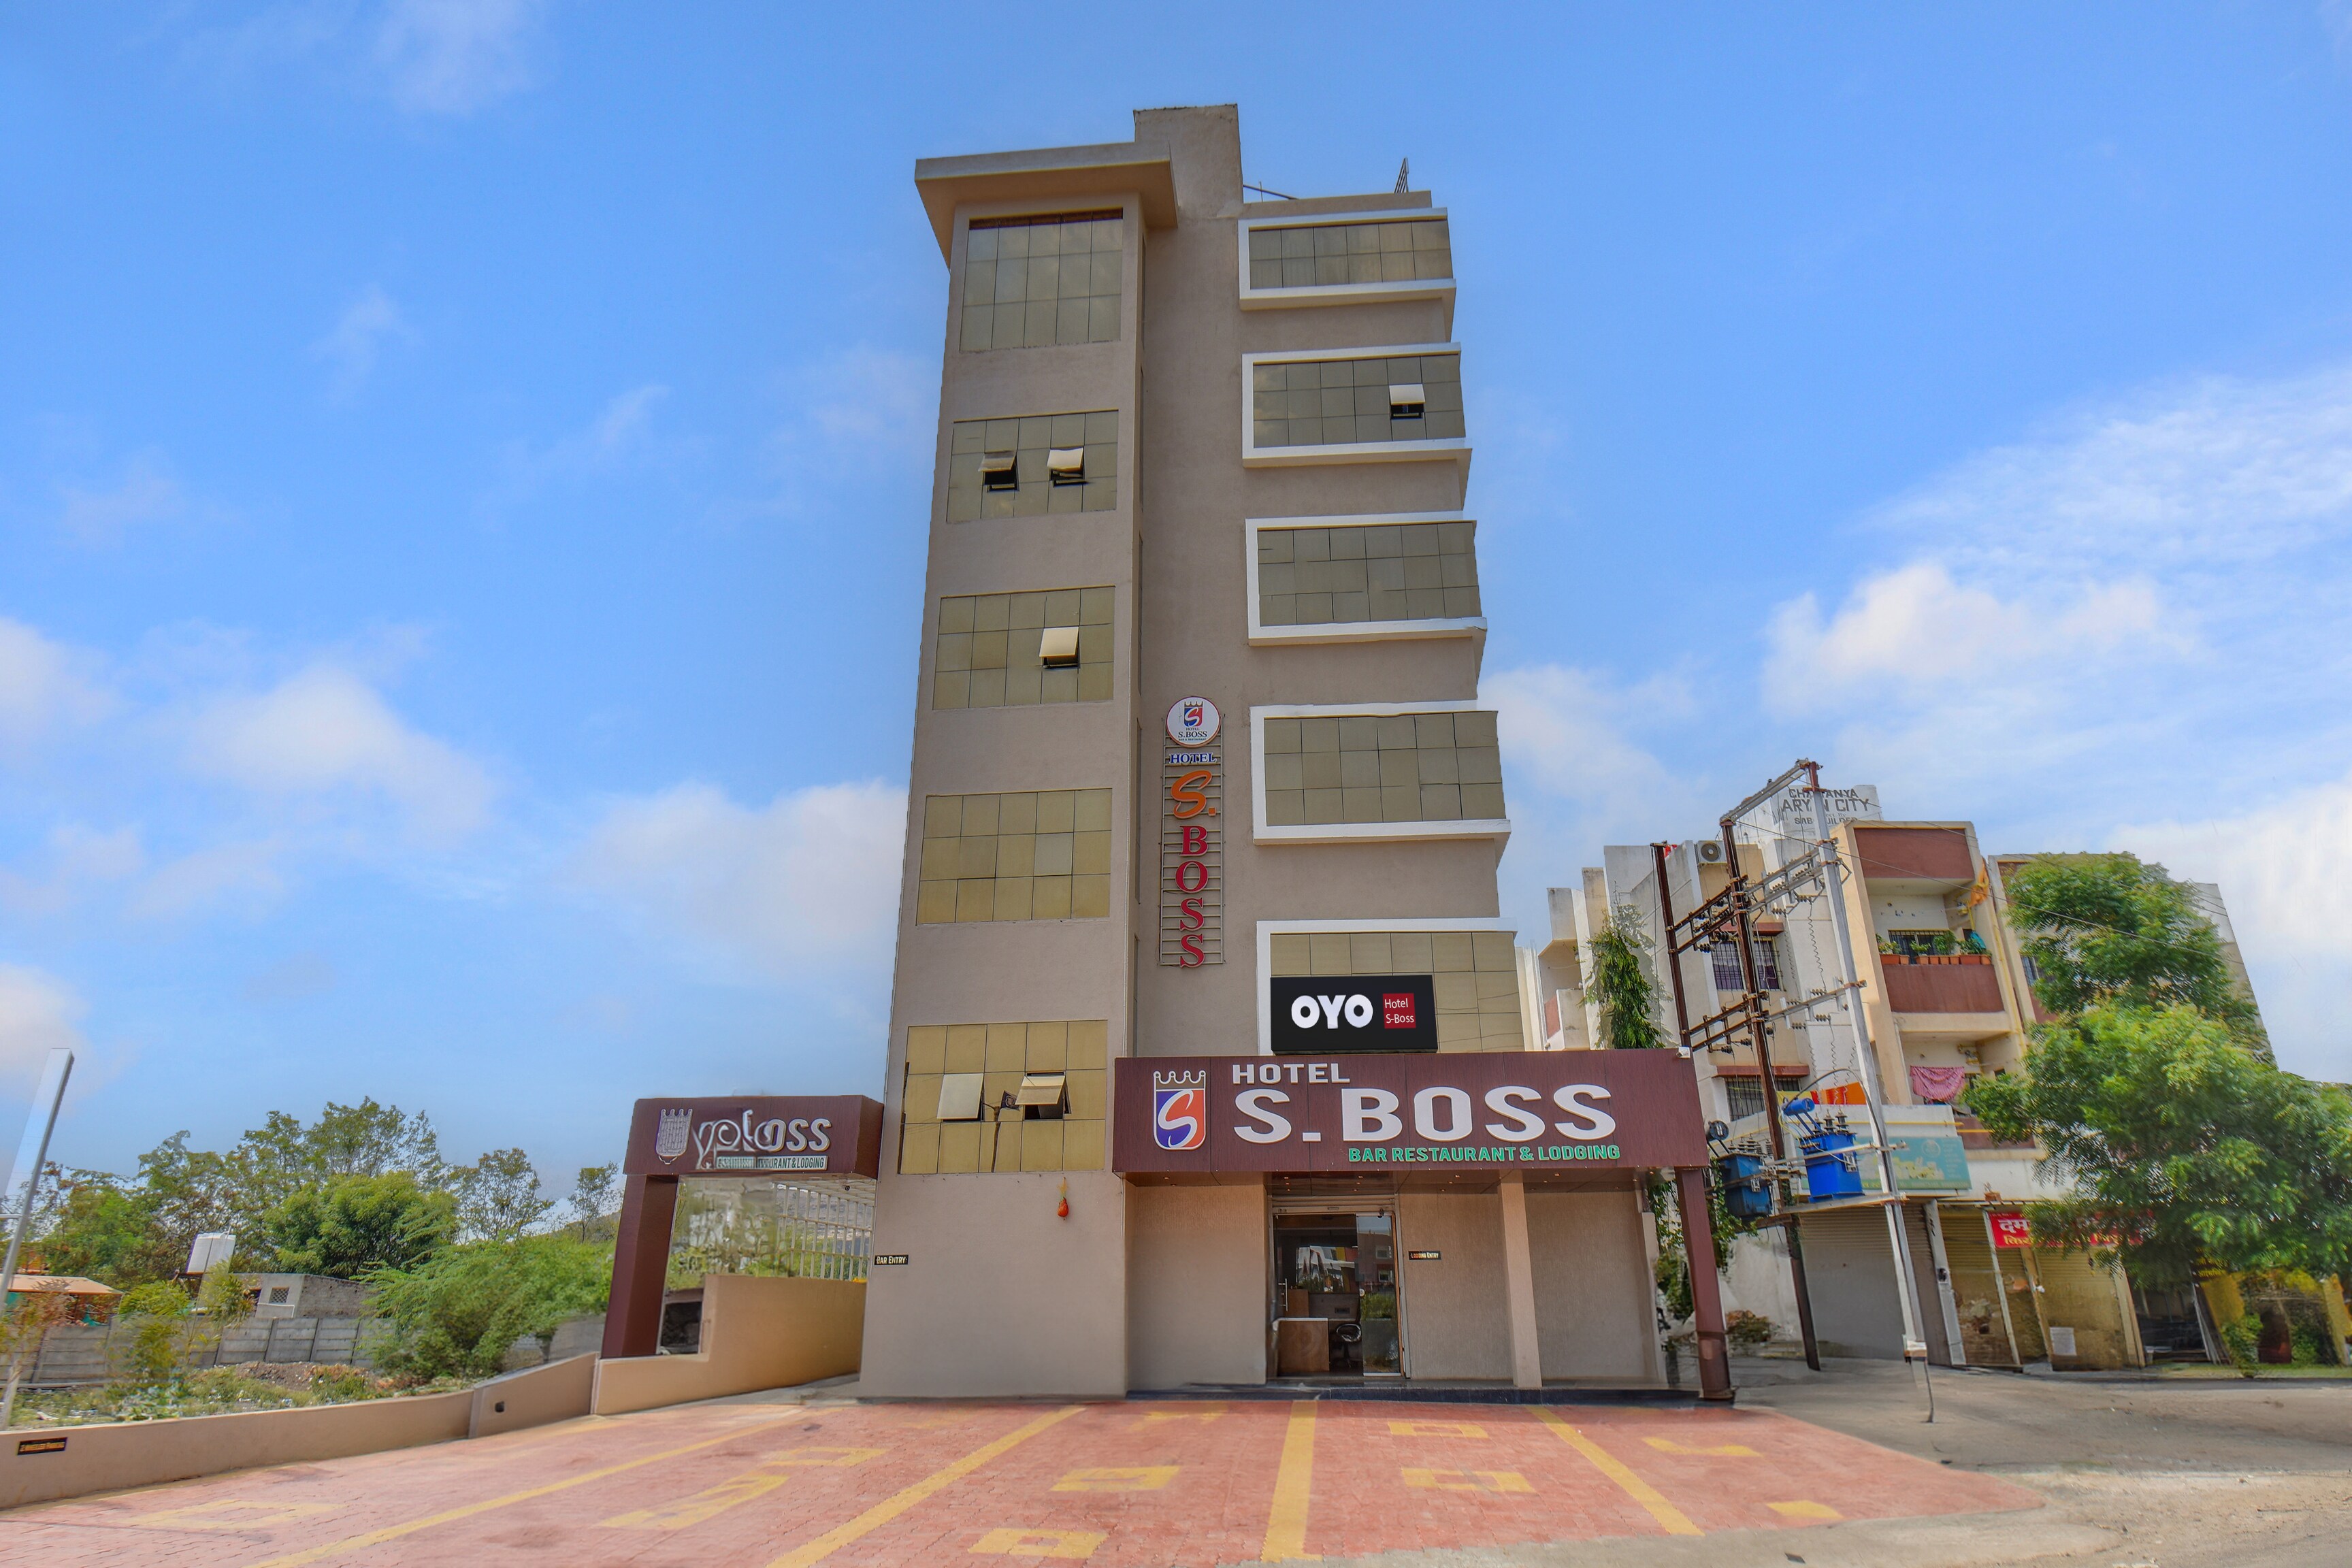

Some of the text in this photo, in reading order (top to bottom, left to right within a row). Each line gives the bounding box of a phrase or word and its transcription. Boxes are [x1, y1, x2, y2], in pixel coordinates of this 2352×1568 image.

[1169, 753, 1217, 764] HOTEL
[1782, 799, 1869, 812] ARYN CITY
[1384, 998, 1408, 1009] Hotel
[1291, 994, 1373, 1029] OYO
[1386, 1013, 1414, 1024] S-Boss
[1232, 1063, 1350, 1085] HOTEL
[1348, 1144, 1621, 1162] BAR RESTAURANT & LODGING
[797, 1157, 825, 1167] LODGING
[888, 1256, 906, 1264] ENTRY
